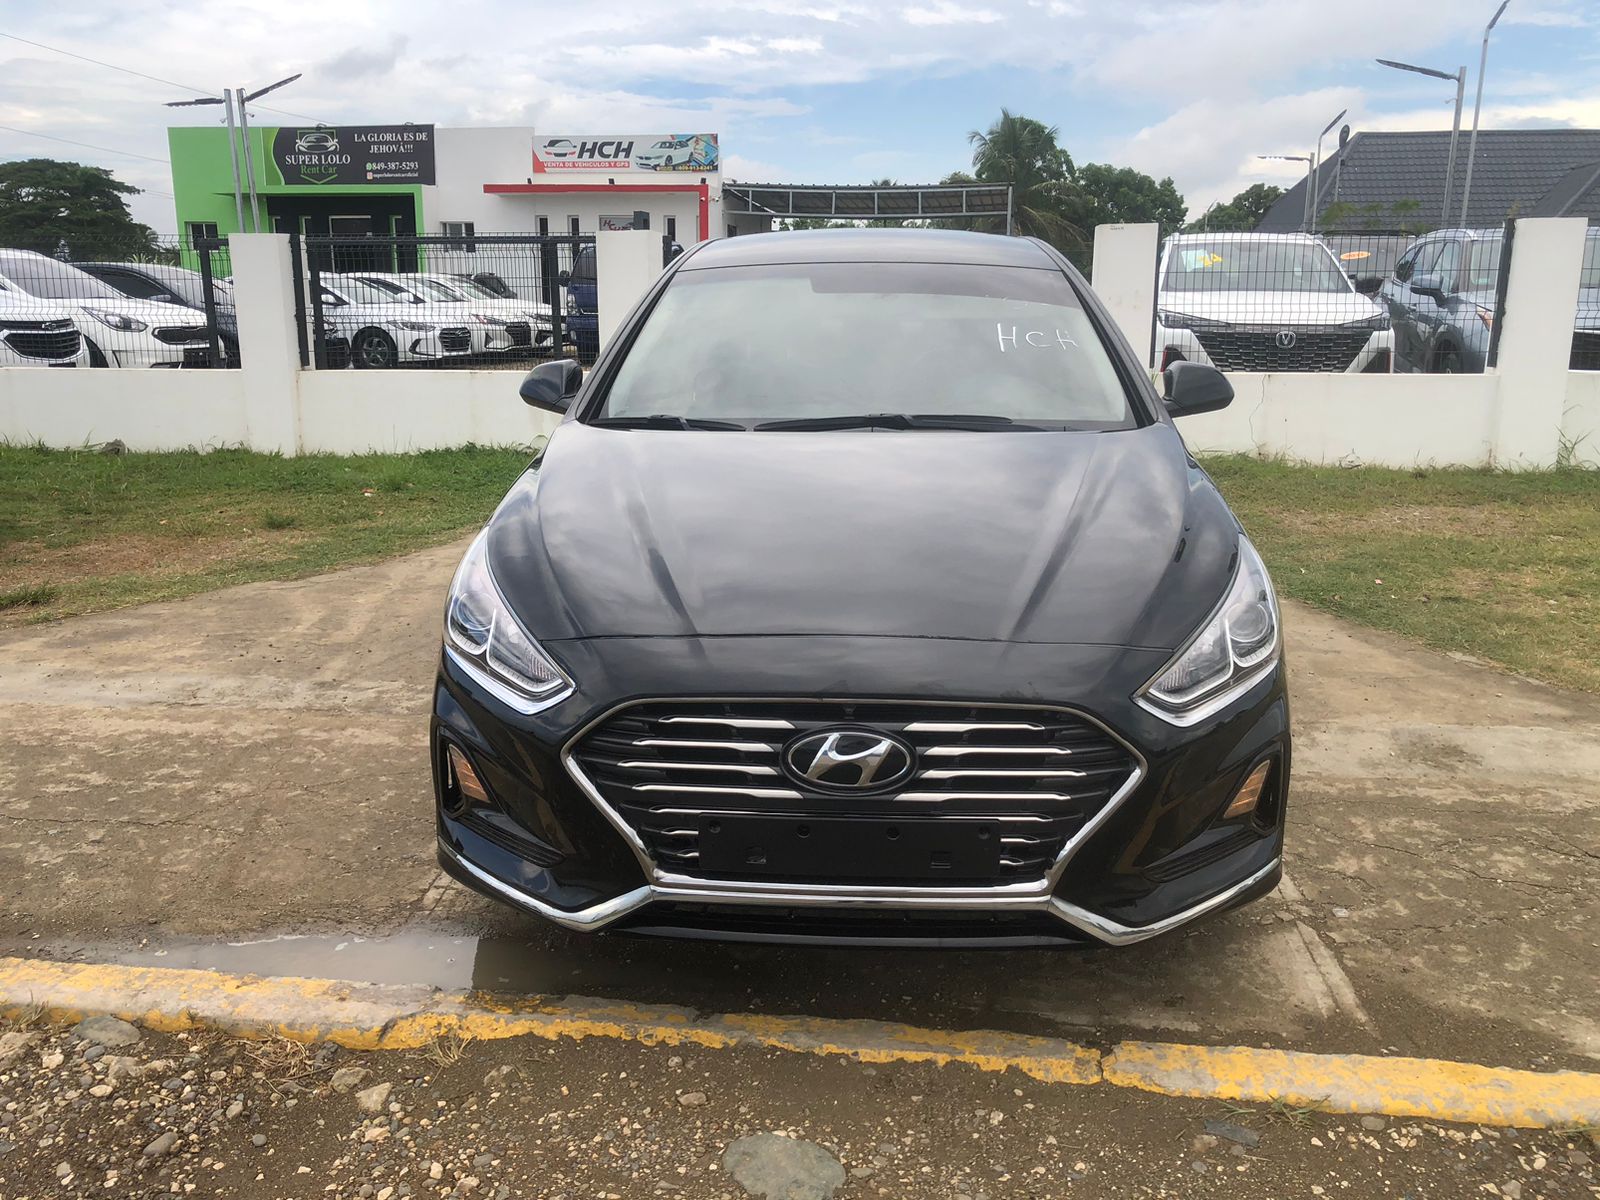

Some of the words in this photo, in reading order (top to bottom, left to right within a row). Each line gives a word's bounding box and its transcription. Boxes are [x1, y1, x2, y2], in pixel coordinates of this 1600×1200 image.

[354, 133, 366, 142] LA
[367, 132, 402, 142] GLORIA
[403, 132, 414, 141] ES
[416, 132, 428, 141] DE
[369, 142, 413, 153] JEHOVÁ!!!
[577, 141, 635, 159] HCH
[285, 154, 319, 165] SUPER
[321, 154, 351, 165] LOLO
[300, 165, 319, 174] Rent
[321, 165, 337, 173] Car
[372, 161, 419, 170] 849-387-5293
